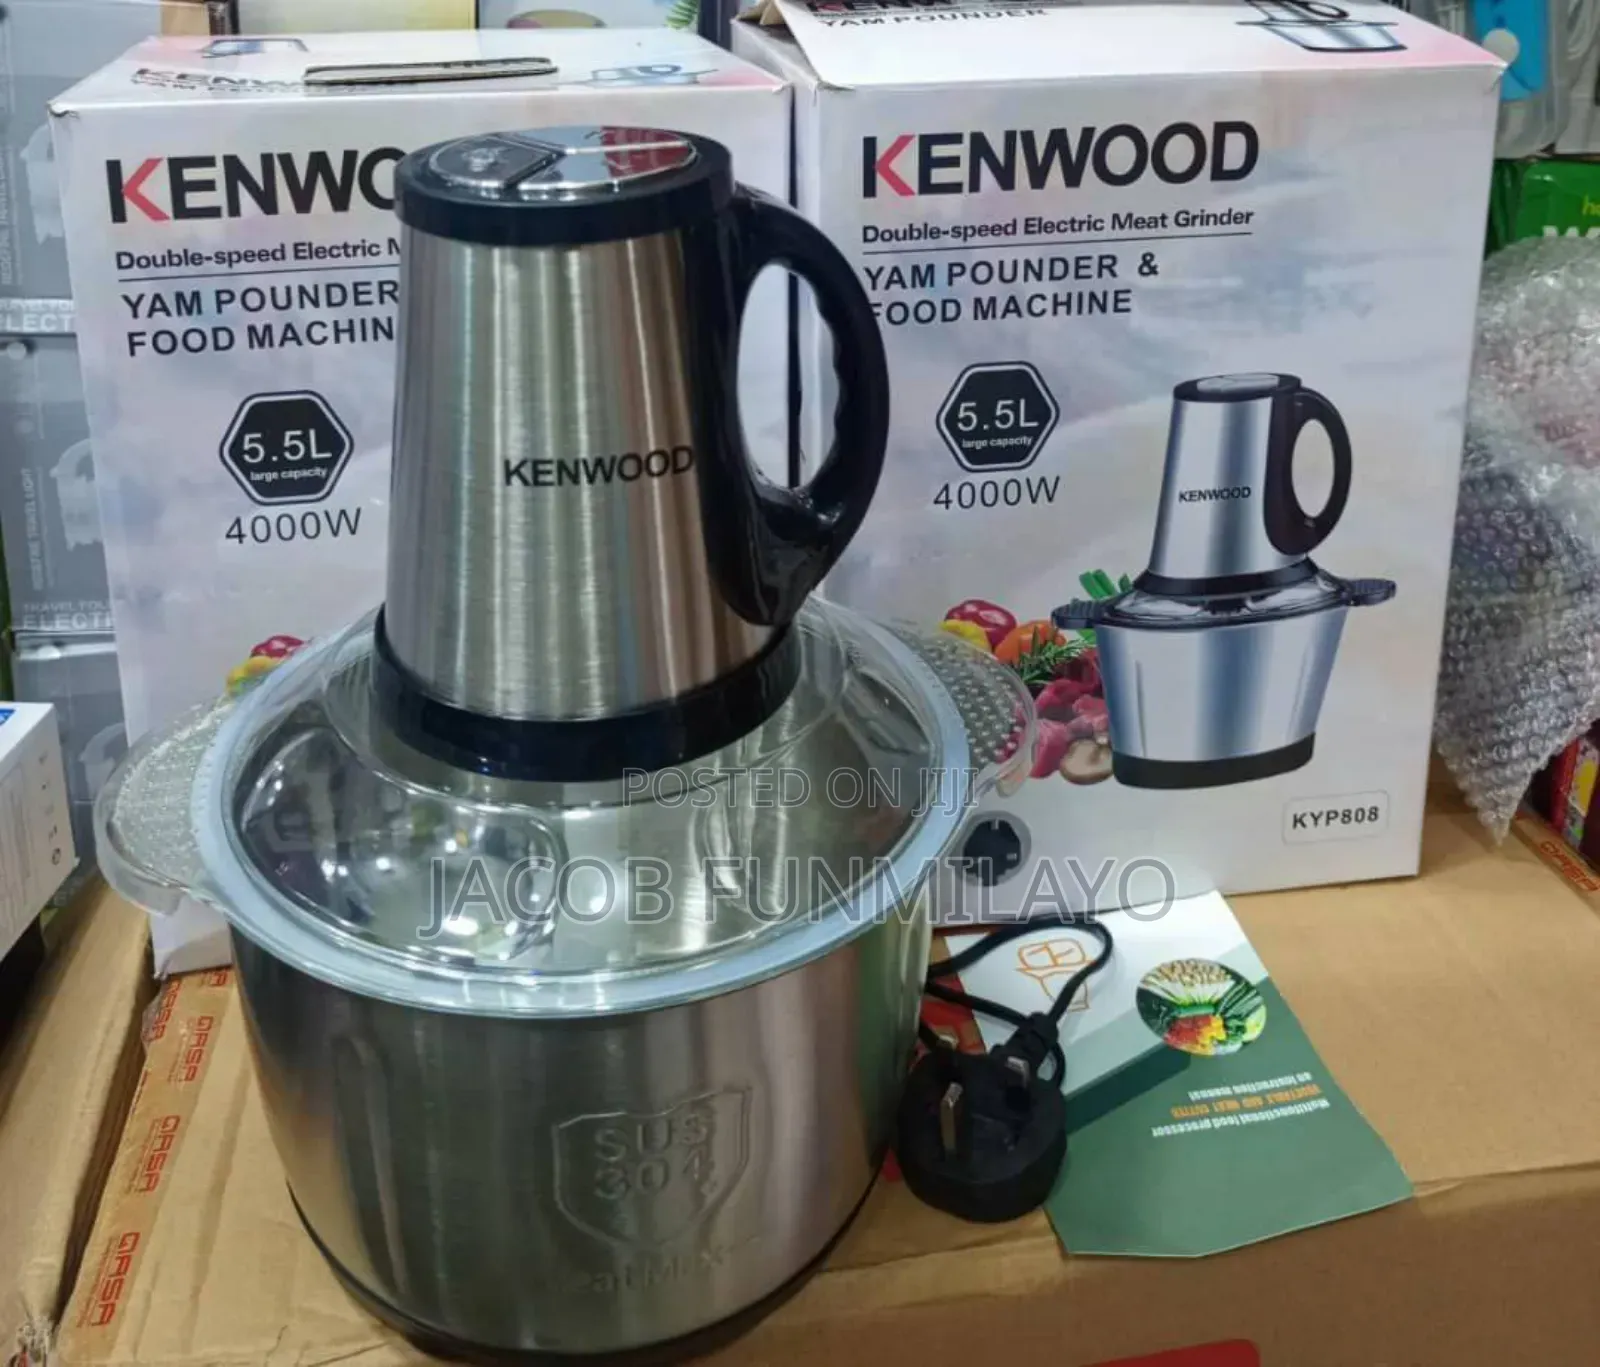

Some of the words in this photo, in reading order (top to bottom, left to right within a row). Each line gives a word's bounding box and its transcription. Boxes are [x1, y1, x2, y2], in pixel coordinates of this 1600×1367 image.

[820, 17, 885, 27] YAM
[893, 9, 1048, 23] POUNDER
[863, 120, 1259, 199] KENWOOD
[106, 147, 405, 224] KENWO
[862, 219, 1017, 243] Double-speed
[1023, 215, 1105, 236] Electric
[1111, 211, 1168, 231] Meat
[1173, 208, 1254, 228] Grinder
[115, 243, 287, 270] Double-speed
[292, 238, 382, 261] Electric
[864, 263, 936, 292] YAM
[947, 254, 1119, 287] POUNDER
[1137, 251, 1160, 277] &
[121, 290, 203, 320] YAM
[214, 279, 400, 315] POUNDER
[973, 288, 1133, 322] MACHINE
[0, 313, 73, 333] LECT
[127, 326, 236, 357] FOOD
[247, 316, 395, 350] MACHIN
[957, 398, 1040, 432] 5.5L
[242, 428, 333, 464] 5.5L
[962, 438, 988, 450] large
[989, 435, 1034, 448] capacity
[250, 470, 279, 483] large
[280, 466, 328, 480] capacity
[503, 445, 694, 487] KENWOOD
[933, 475, 1061, 511] 4000W
[1178, 485, 1252, 503] KENWOOD
[225, 506, 362, 545] 4000W
[1291, 805, 1380, 830] KYP808
